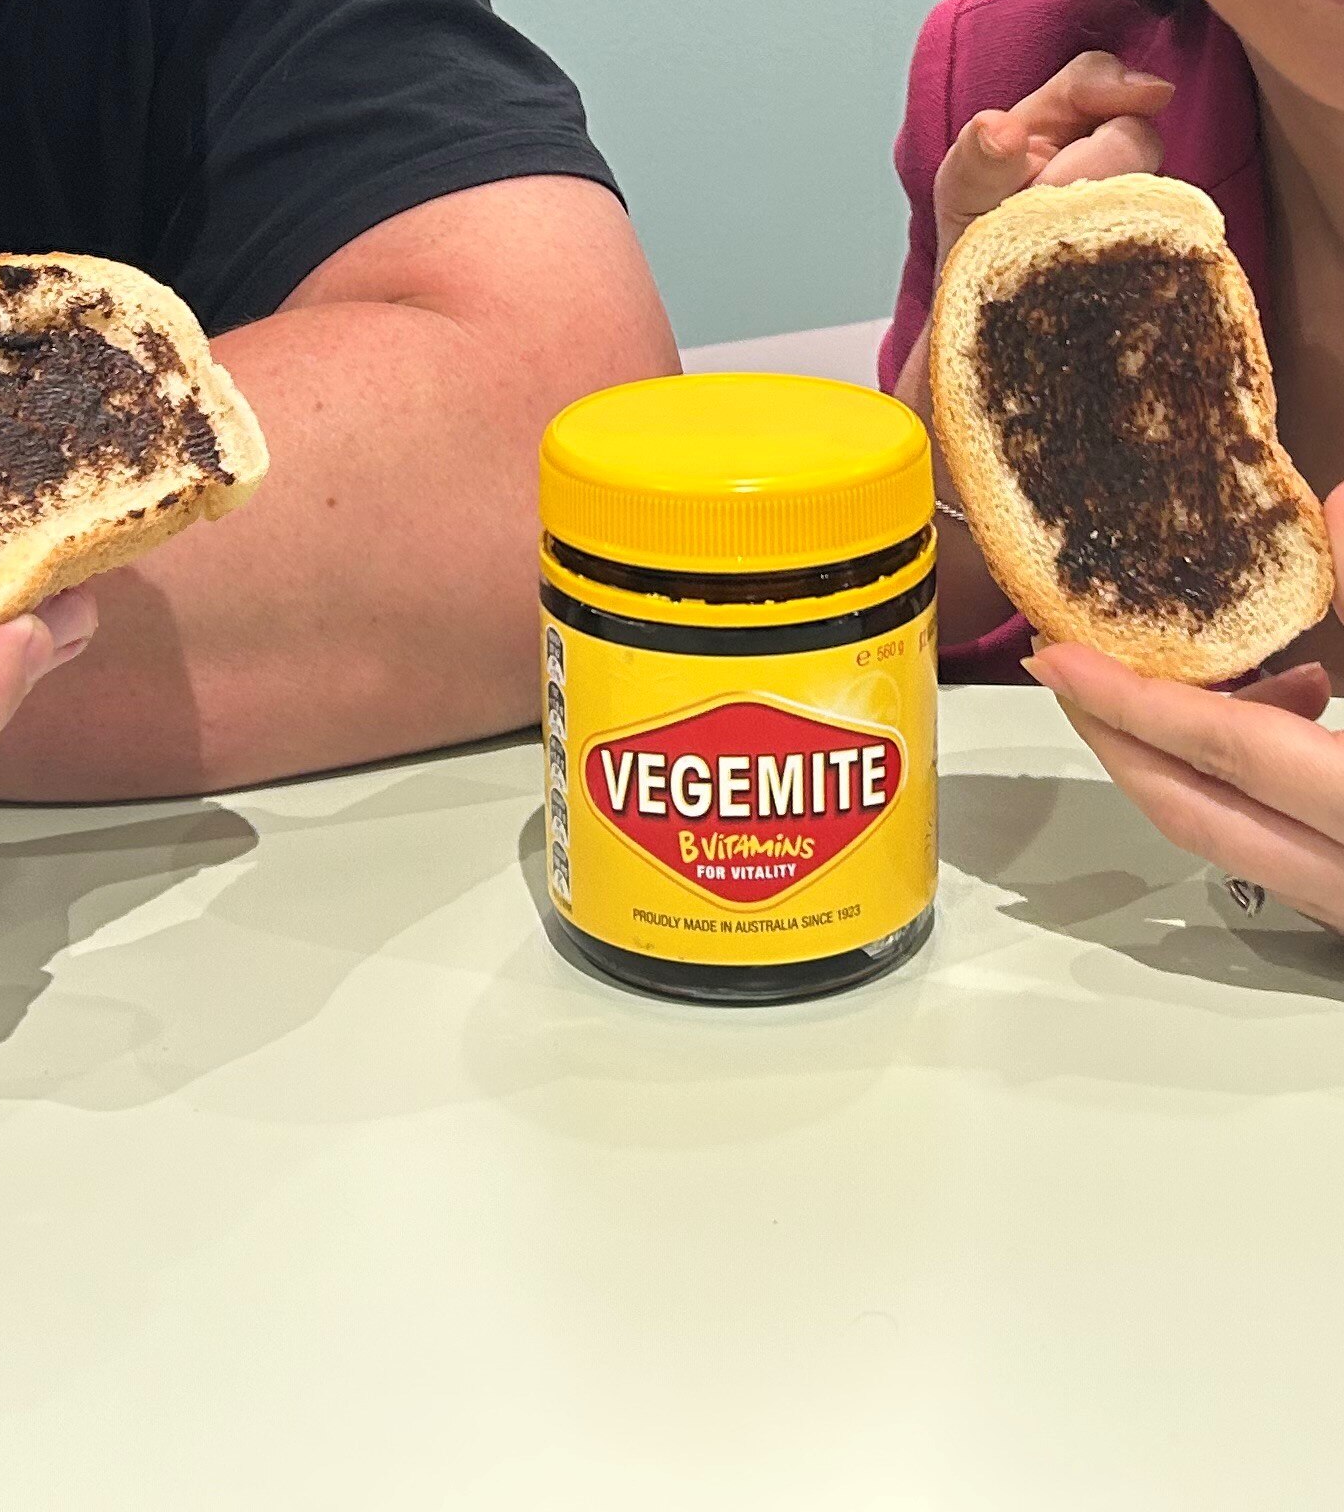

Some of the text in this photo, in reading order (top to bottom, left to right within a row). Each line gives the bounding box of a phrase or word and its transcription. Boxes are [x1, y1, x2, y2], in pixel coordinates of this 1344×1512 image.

[600, 743, 887, 818] VEGEMITE
[678, 830, 700, 864] B
[696, 863, 797, 880] FOR VITALITY
[632, 904, 861, 933] PROUDLY MADE IN AUSTRALIA SINCE 1923
